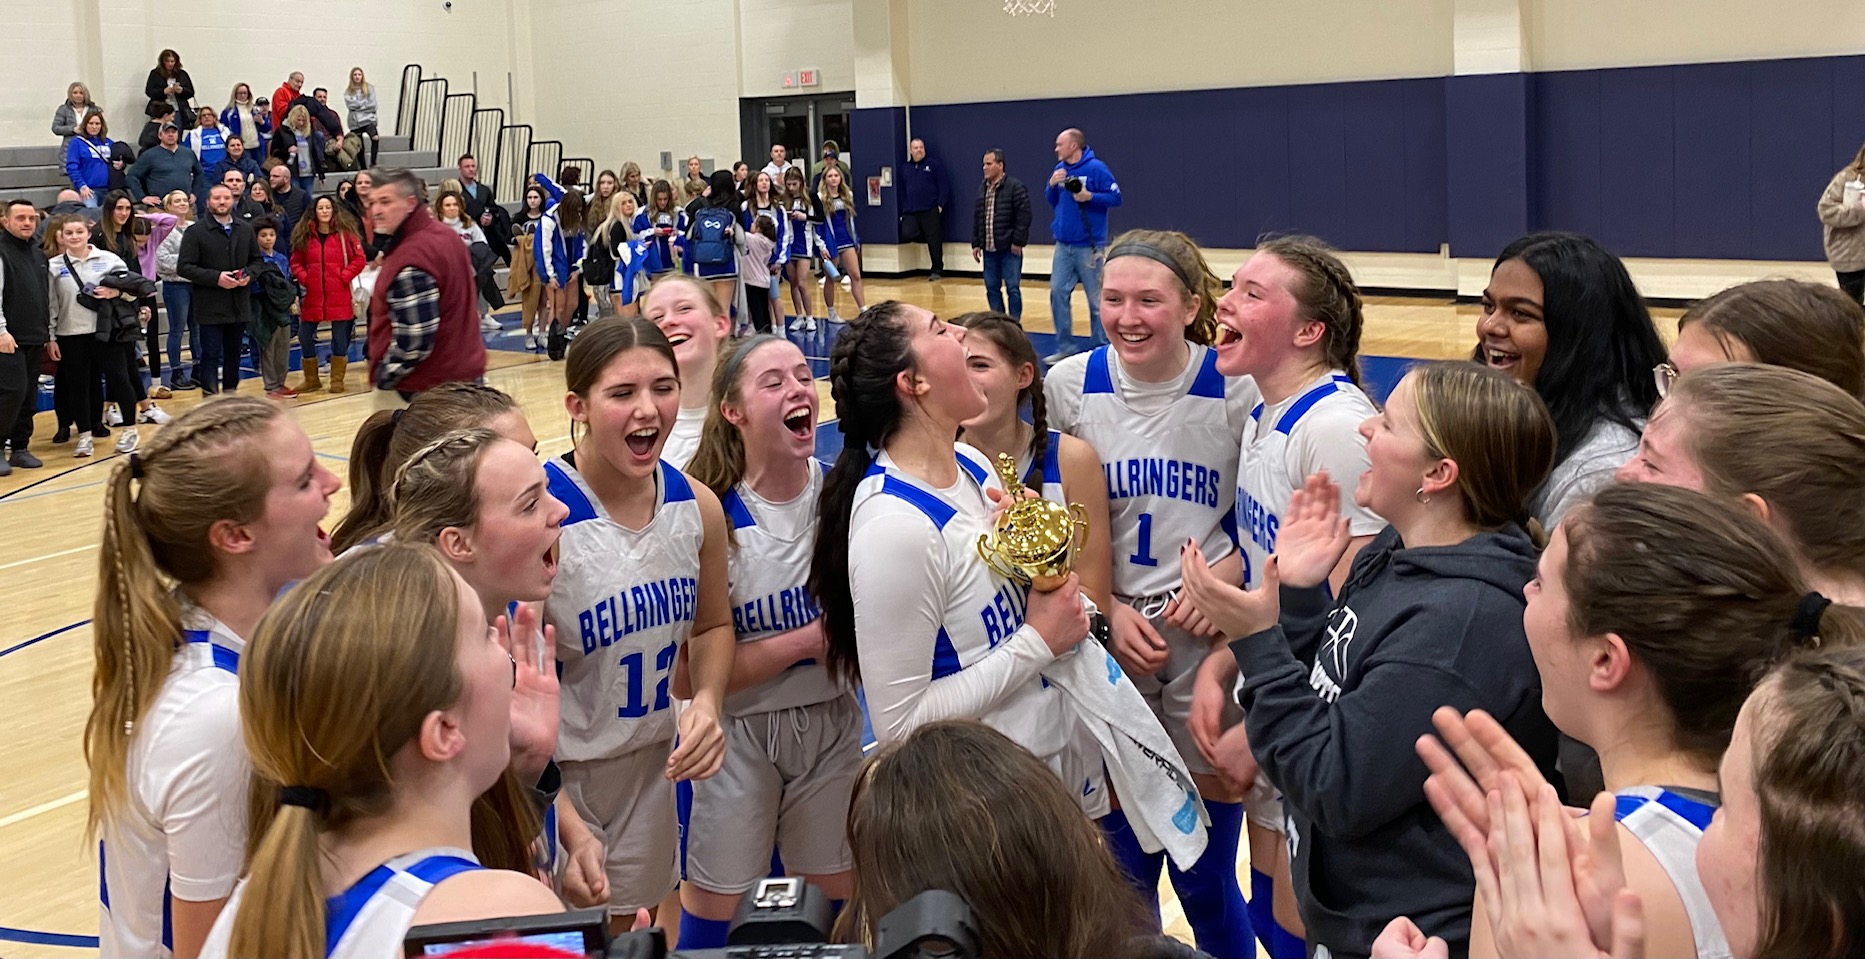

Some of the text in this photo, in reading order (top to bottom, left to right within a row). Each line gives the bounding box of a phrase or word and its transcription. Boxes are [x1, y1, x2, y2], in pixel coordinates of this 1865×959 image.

[1101, 458, 1215, 509] LLRINGERS
[1129, 512, 1158, 567] 1
[980, 577, 1031, 650] BELL
[618, 640, 678, 718] 12
